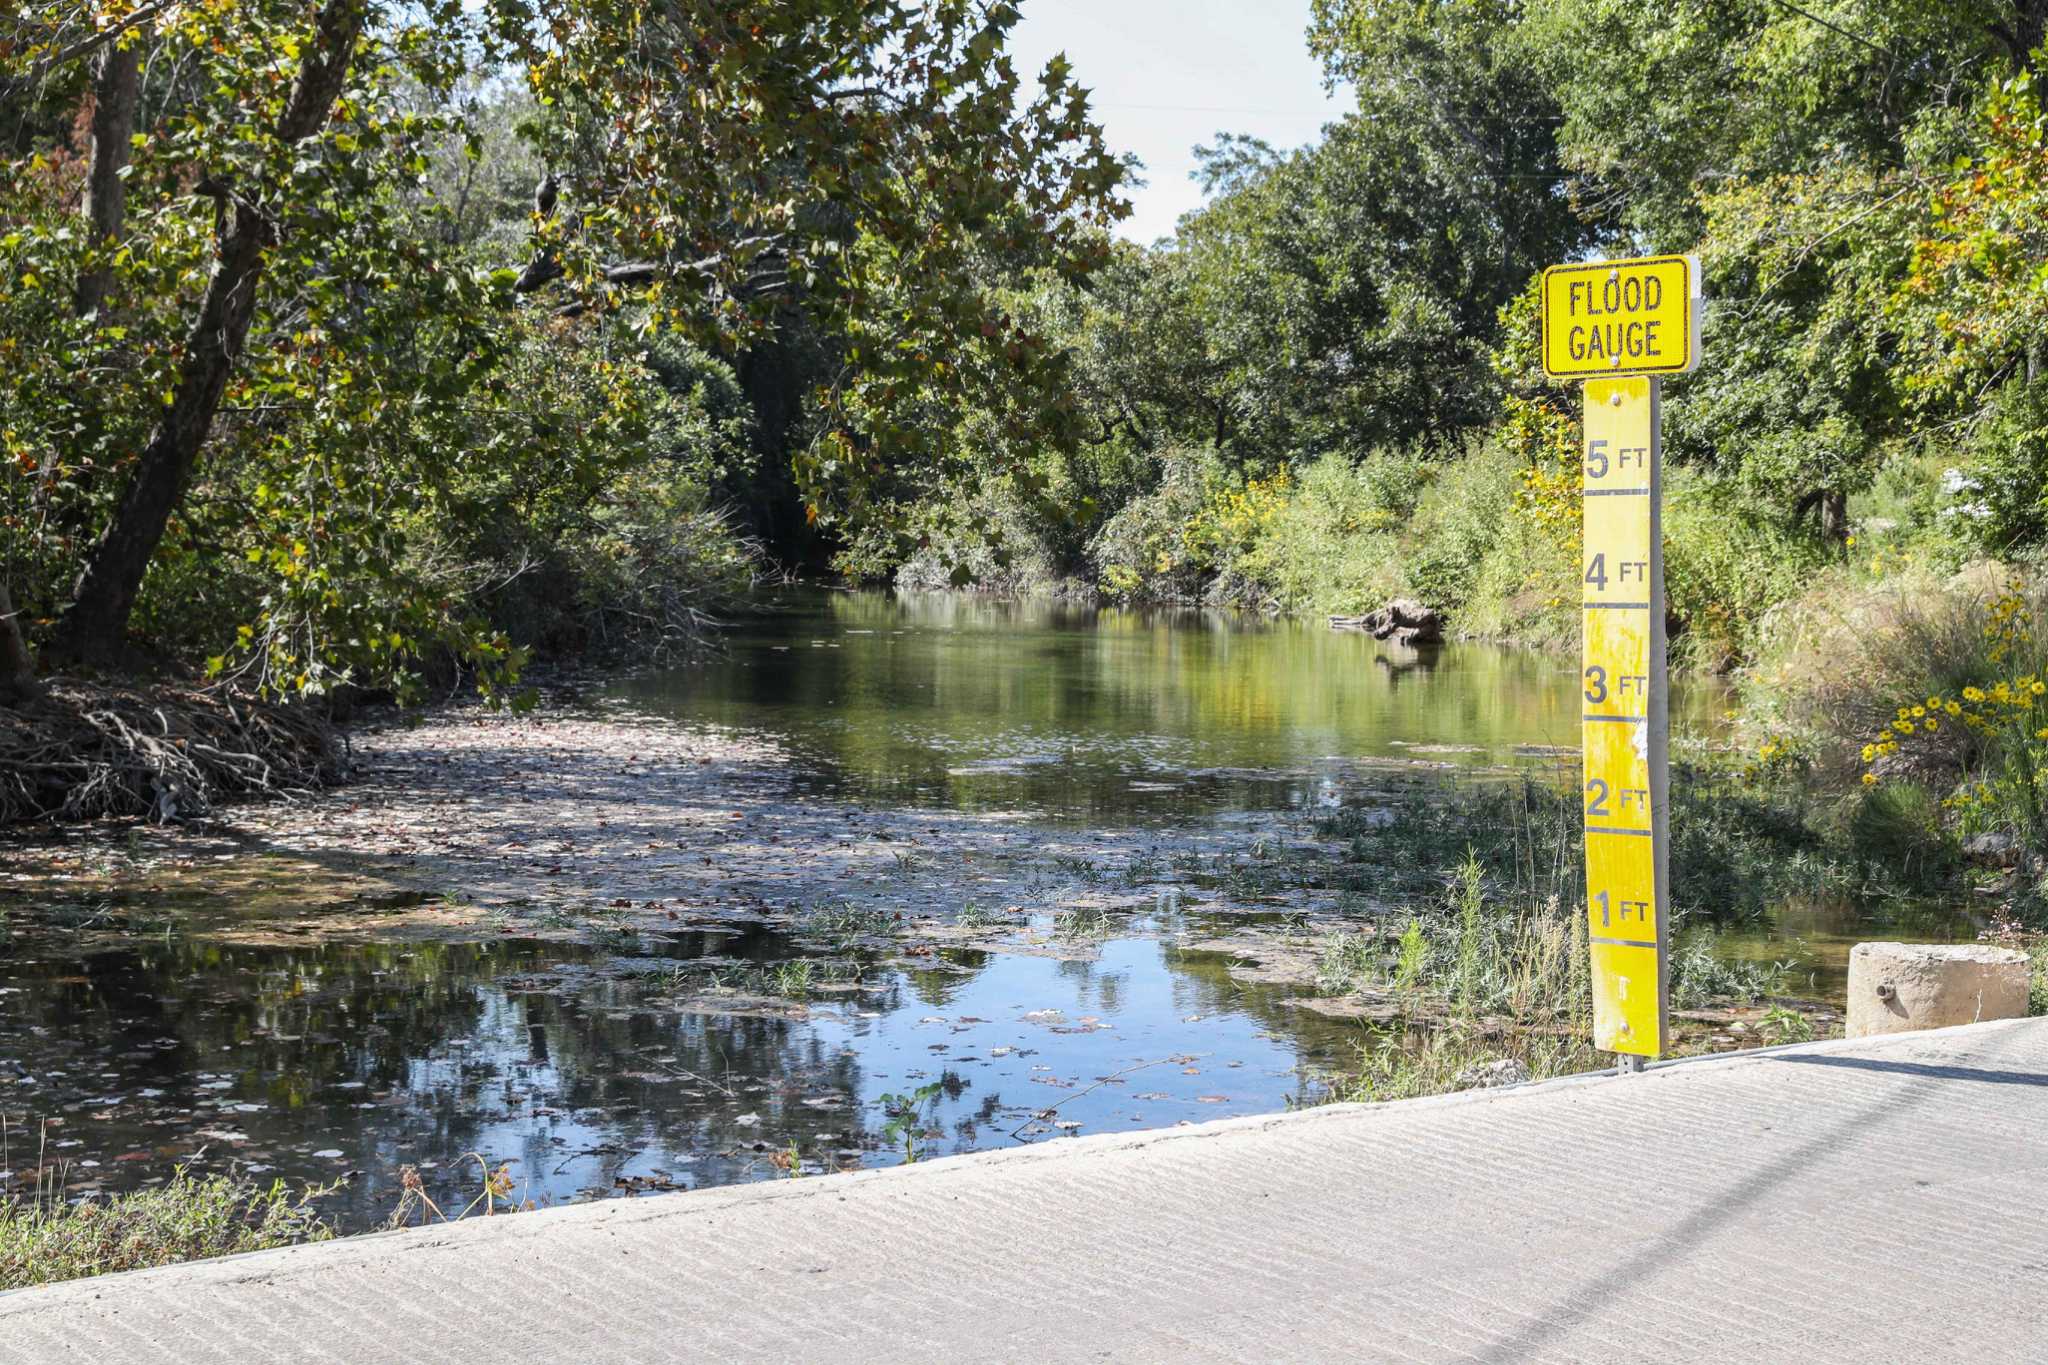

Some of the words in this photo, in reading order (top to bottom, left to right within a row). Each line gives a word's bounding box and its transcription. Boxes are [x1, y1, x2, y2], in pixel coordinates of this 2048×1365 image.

[1569, 275, 1662, 316] FLOOD
[1569, 321, 1661, 360] GAUGE
[1586, 440, 1609, 479] 5
[1619, 448, 1647, 468] FT
[1584, 553, 1609, 591] 4
[1619, 562, 1647, 582] FT
[1584, 665, 1608, 704] 3
[1619, 675, 1647, 695] FT
[1586, 778, 1610, 816] 2
[1619, 788, 1647, 809] FT
[1594, 889, 1610, 928] 1
[1619, 900, 1648, 922] FT
